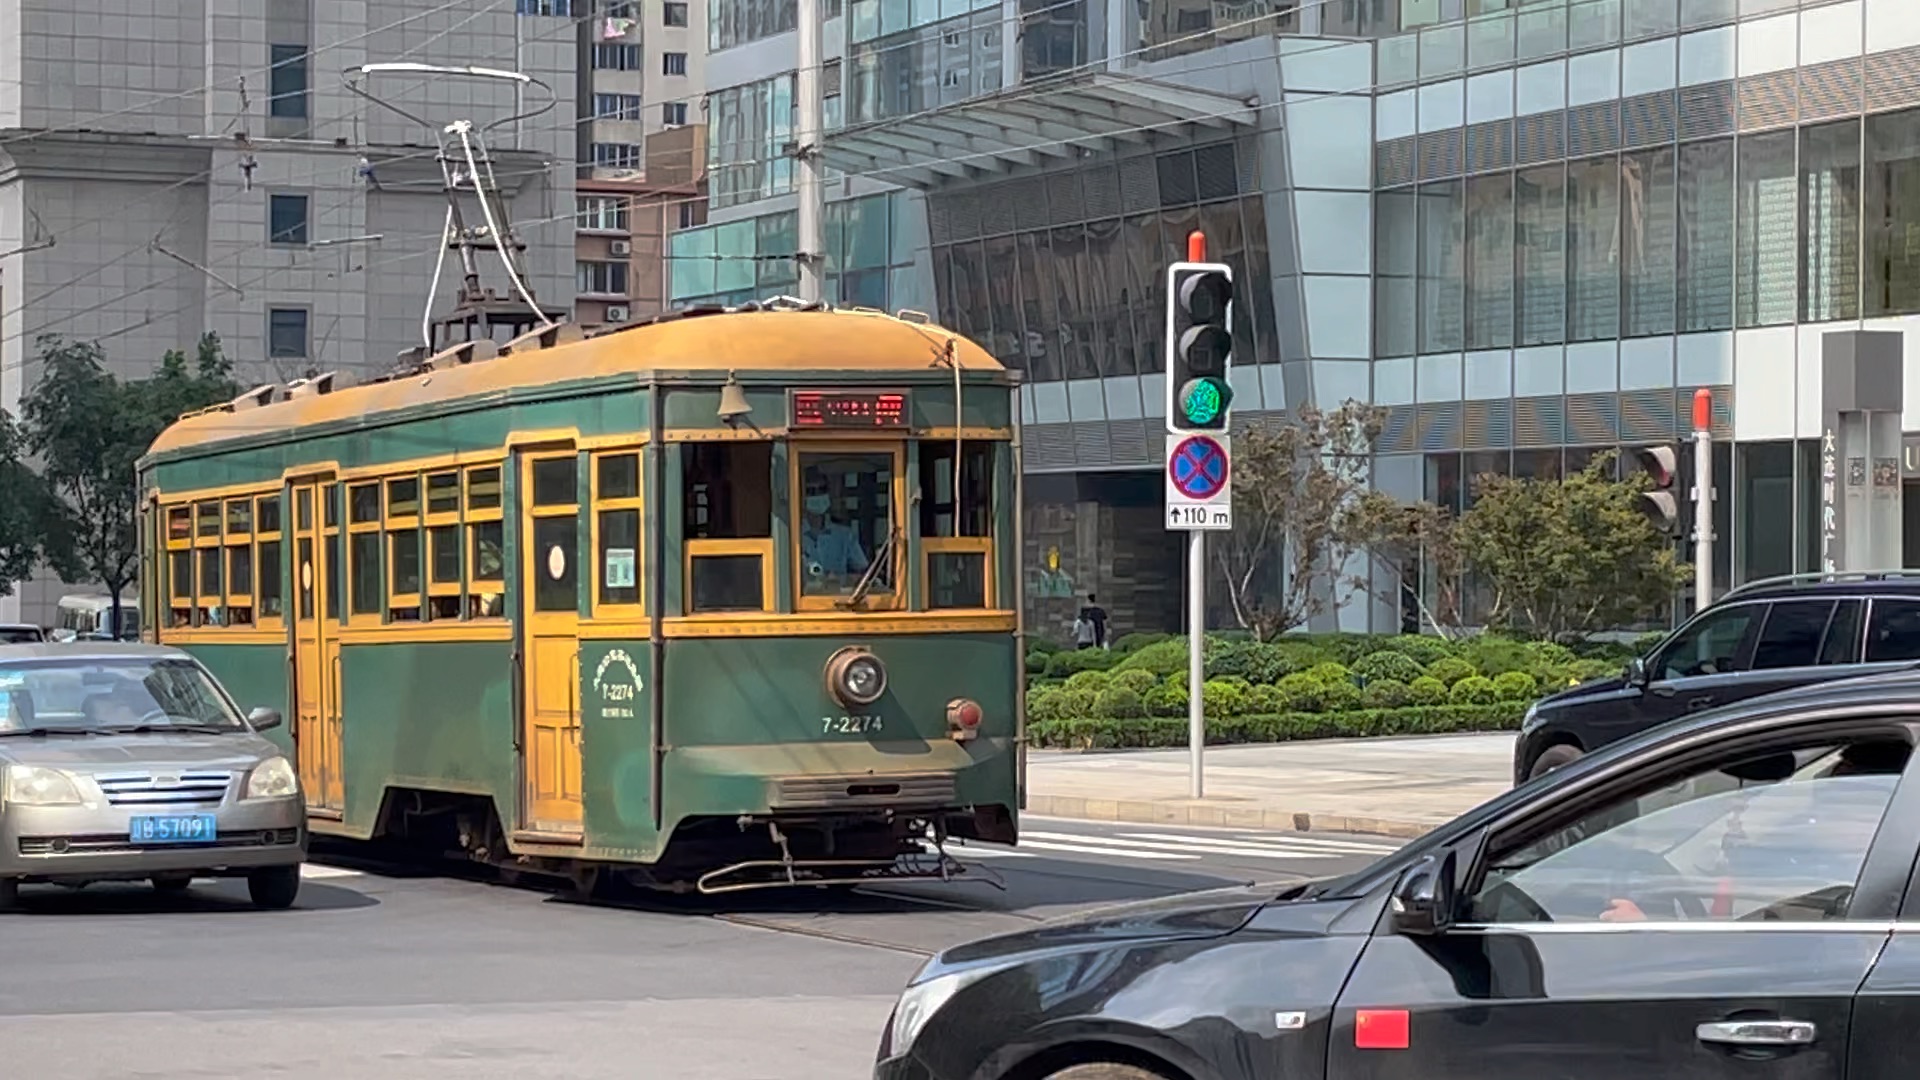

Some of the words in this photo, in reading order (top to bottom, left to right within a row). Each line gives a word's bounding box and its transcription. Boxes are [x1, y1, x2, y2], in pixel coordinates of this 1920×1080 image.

[1184, 507, 1207, 524] 110
[1213, 512, 1228, 524] m
[822, 715, 883, 734] 7-2274
